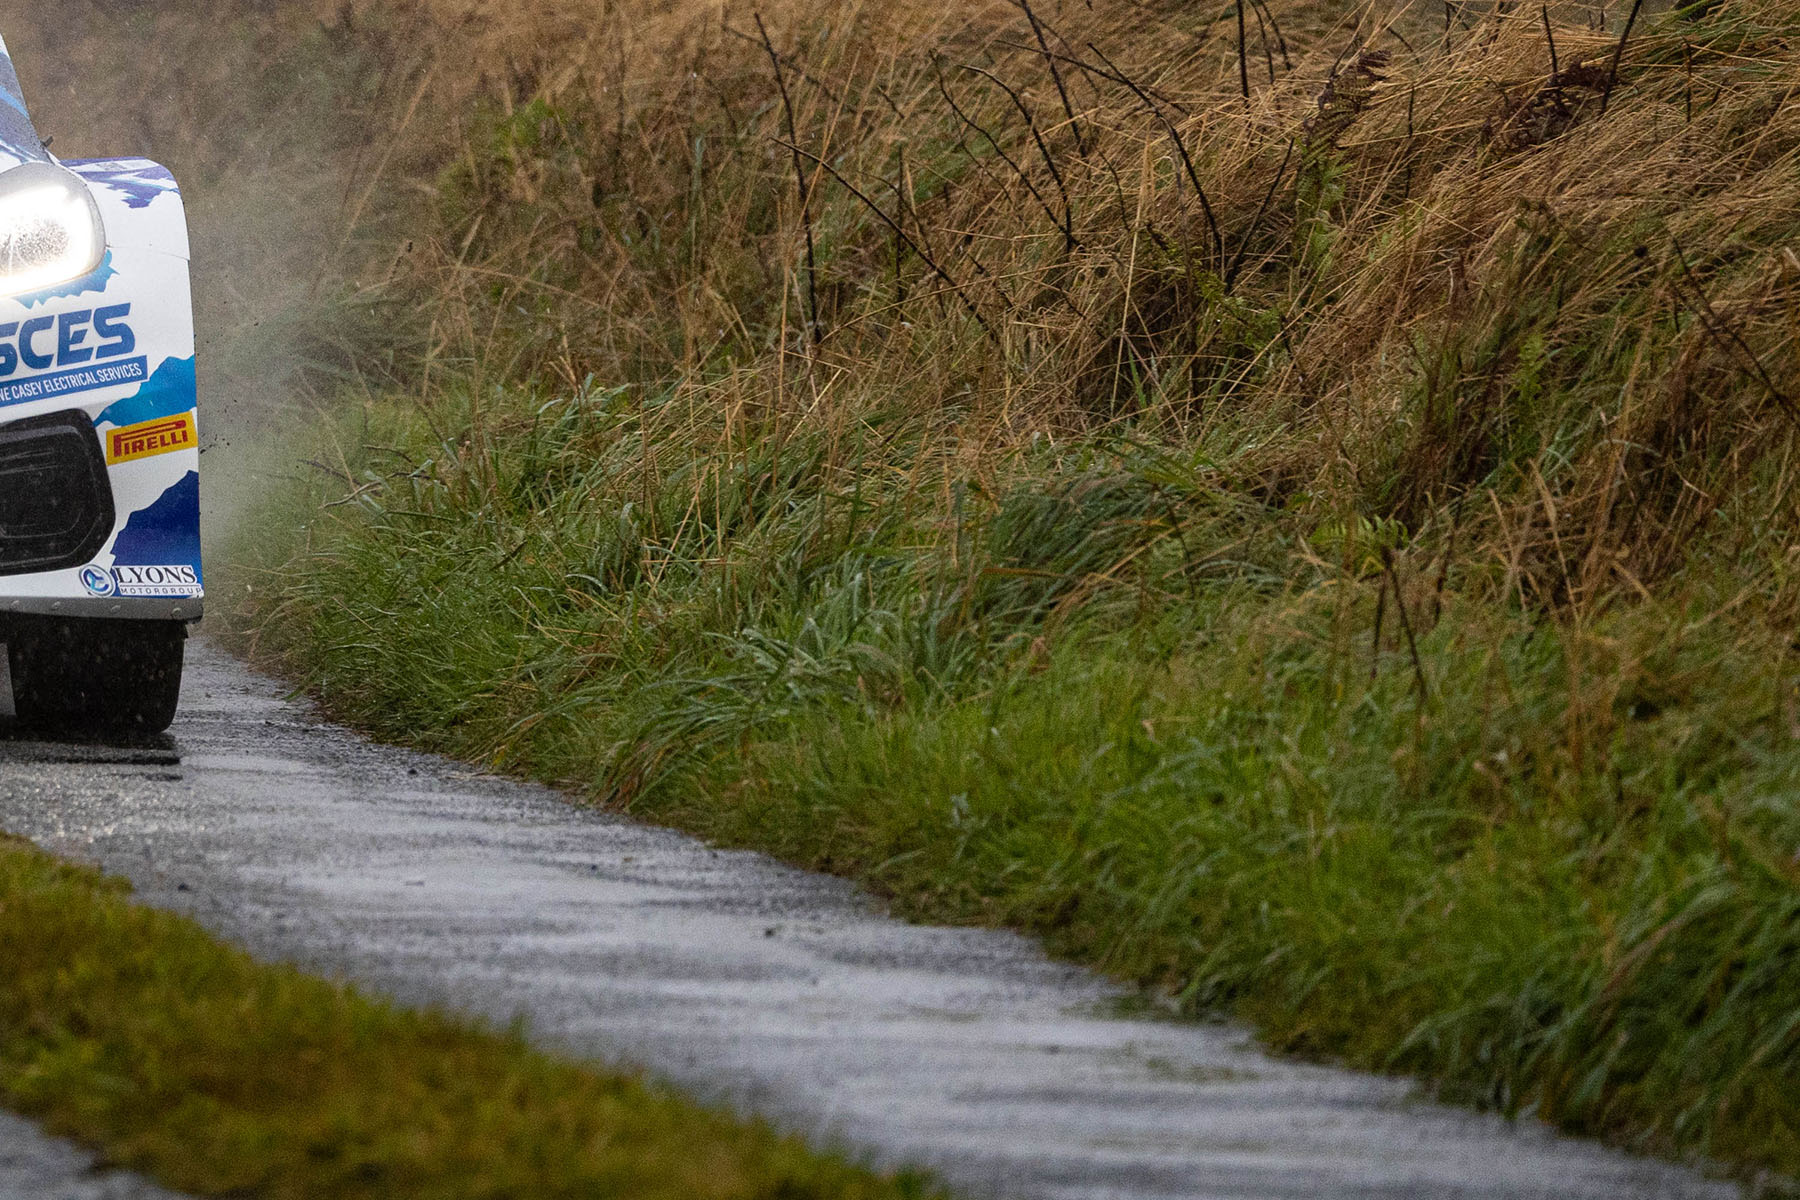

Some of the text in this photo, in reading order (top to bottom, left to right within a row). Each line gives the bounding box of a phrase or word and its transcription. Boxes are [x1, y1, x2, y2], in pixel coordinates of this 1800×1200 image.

[10, 380, 44, 400] CASEY
[45, 371, 99, 393] ELECTRICAL
[99, 362, 143, 384] SERVICES
[113, 419, 189, 458] PIRELLI
[114, 566, 197, 584] LYONS
[120, 587, 202, 595] MOTORGROUP
